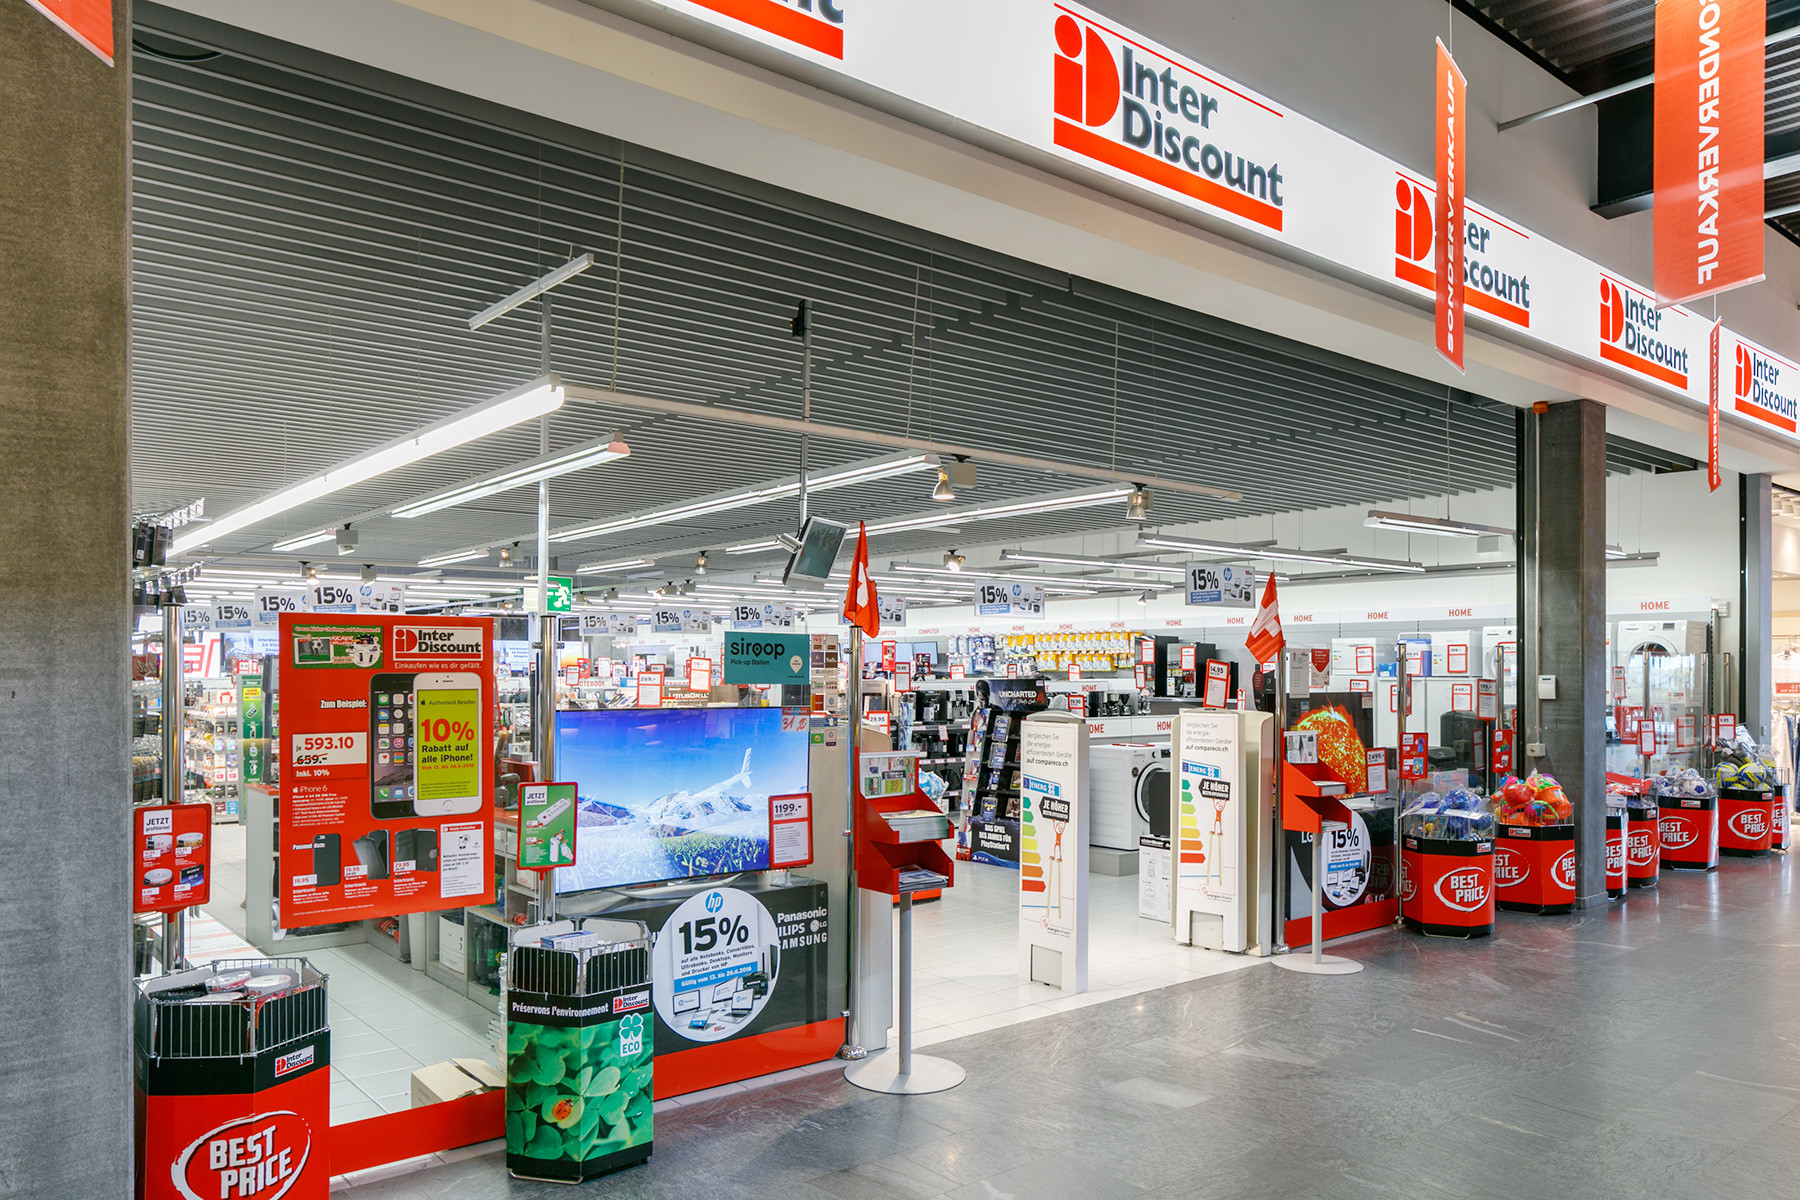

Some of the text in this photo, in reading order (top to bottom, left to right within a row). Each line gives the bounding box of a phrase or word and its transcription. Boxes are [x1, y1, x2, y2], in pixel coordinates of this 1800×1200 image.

[1122, 45, 1218, 129] Inter
[1122, 95, 1283, 207] Discount
[1447, 70, 1455, 354] SONDERVERKAUF
[1625, 290, 1661, 332] Inter
[1625, 320, 1688, 374] Discount
[1753, 352, 1779, 385] Inter
[1752, 379, 1797, 420] Discount
[1191, 569, 1219, 590] 15%
[314, 587, 353, 604] 15%
[980, 586, 1007, 604] 15%
[260, 597, 295, 611] 15%
[1641, 601, 1670, 610] HOME
[216, 606, 248, 620] 15%
[655, 611, 679, 624] 15%
[734, 605, 760, 621] 15%
[584, 616, 606, 627] 15%
[418, 630, 454, 641] Inter
[418, 641, 481, 652] Discount
[730, 638, 785, 660] siroop
[1210, 666, 1224, 674] 14.95
[998, 690, 1037, 698] UNCHARTED
[320, 699, 367, 709] Zum Beispiel:
[421, 718, 475, 742] 10%
[1089, 724, 1104, 733] OME
[1157, 721, 1171, 730] HOM
[1026, 732, 1051, 740] Vergleichen
[304, 736, 354, 750] 593.10
[422, 743, 469, 752] Rabatt auf
[1194, 744, 1228, 753] compareco.ch
[296, 755, 327, 765] 659.-
[422, 754, 473, 763] alle iPhone!
[1056, 751, 1072, 759] Geräte
[1368, 752, 1385, 760] 2499.-
[1035, 758, 1068, 768] compareco.ch
[1190, 765, 1206, 774] ENERG
[313, 769, 330, 777] 10%
[1031, 781, 1047, 792] ENERG
[1203, 781, 1228, 793] JE HÖHER
[775, 803, 801, 813] 1199.-
[1043, 800, 1068, 814] JE HÖHER
[146, 817, 169, 825] JETZT
[1741, 813, 1762, 824] BEST
[984, 824, 1005, 834] DAS SPIEL
[1660, 822, 1682, 832] BEST
[1744, 822, 1766, 833] PRICE
[1331, 828, 1359, 849] 15%
[1627, 835, 1648, 848] BEST
[1663, 832, 1689, 842] PRICE
[1631, 845, 1652, 858] PRICE
[1450, 873, 1479, 889] BEST
[1456, 886, 1485, 903] PRICE
[777, 906, 828, 924] Panasonic
[679, 914, 749, 955] 15%
[779, 922, 805, 937] ILIPS
[700, 951, 725, 959] Notebooks,
[726, 945, 755, 953] Convertibles,
[681, 961, 708, 970] Ultrabooks,
[709, 956, 731, 964] Desktops,
[691, 966, 709, 974] Drucker
[681, 979, 697, 987] Gültig
[512, 1002, 550, 1016] Préservons
[551, 1003, 609, 1017] l'environnement
[622, 998, 648, 1008] Discount
[622, 1041, 640, 1054] ECO
[286, 1052, 302, 1063] Inter
[286, 1053, 313, 1069] Discount
[210, 1125, 276, 1170] BEST
[221, 1147, 292, 1199] PRICE
